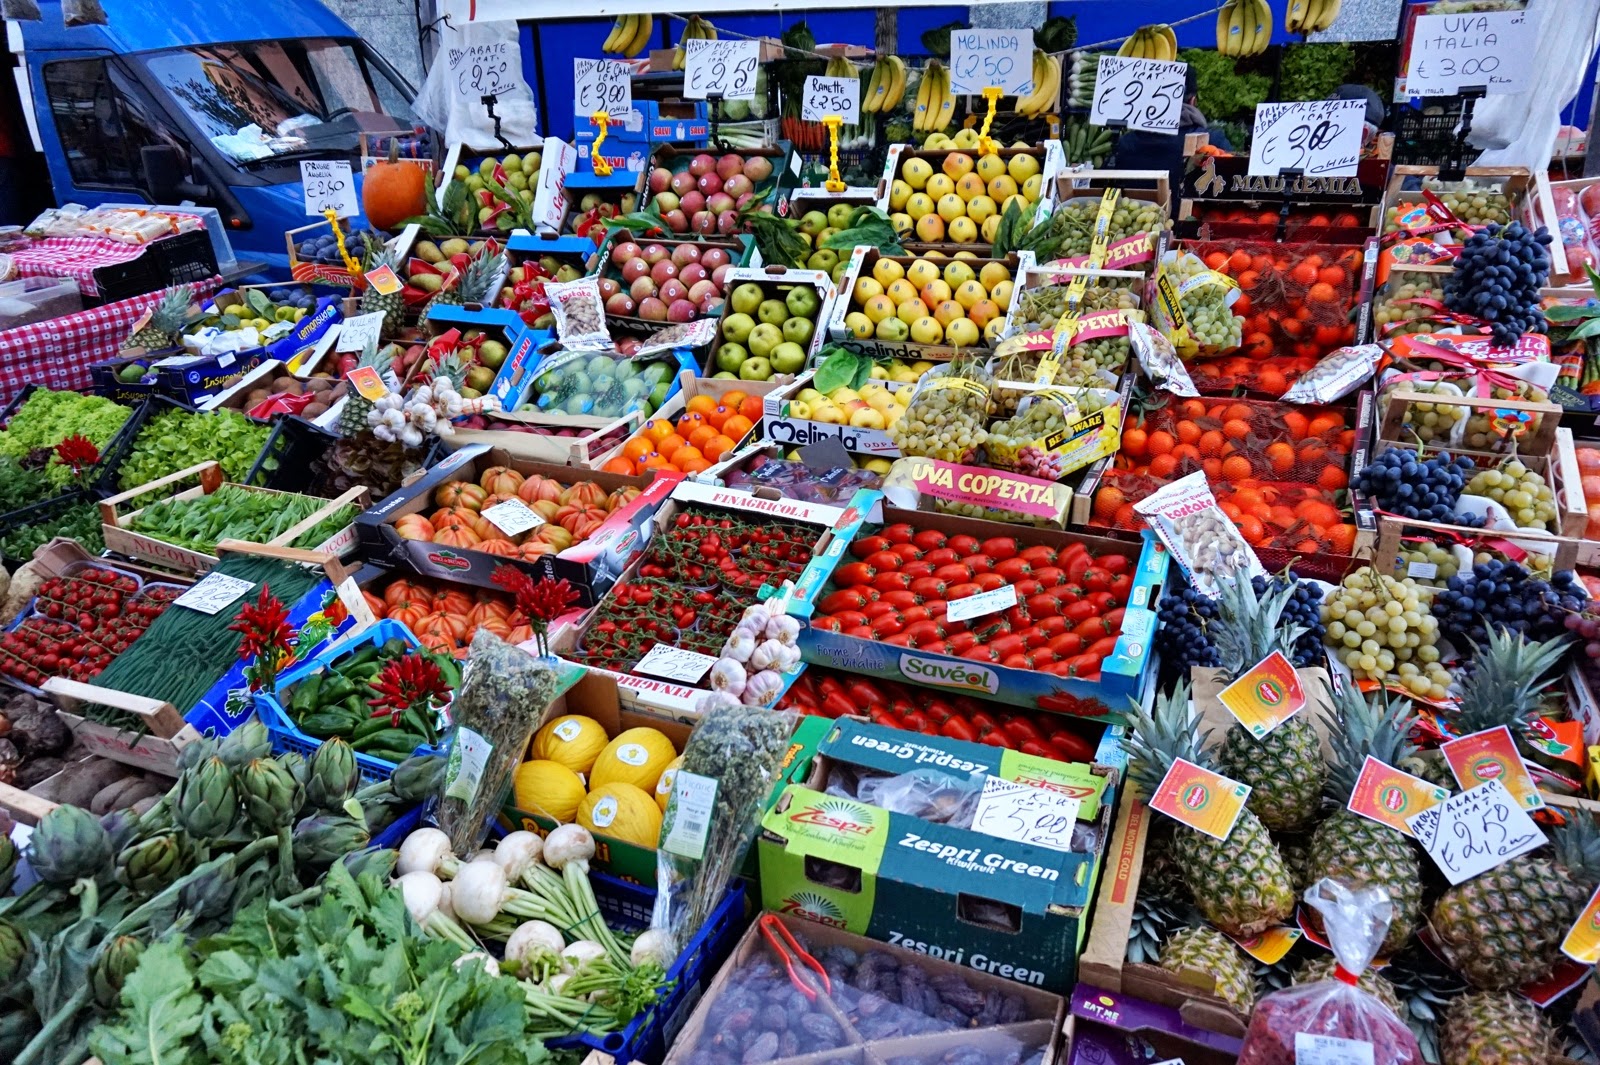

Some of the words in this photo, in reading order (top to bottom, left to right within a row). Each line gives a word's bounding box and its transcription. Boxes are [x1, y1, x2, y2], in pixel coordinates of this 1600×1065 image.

[1444, 16, 1488, 33] UVA
[470, 43, 506, 56] ABATE
[1425, 33, 1498, 49] ITALIA
[1080, 237, 1153, 269] CPERTA
[511, 337, 531, 371] SALVI
[839, 342, 922, 358] Melinda
[1472, 350, 1535, 359] Scelta
[1049, 416, 1102, 447] BEWARE
[911, 463, 953, 489] UVA
[958, 473, 1055, 507] COPERTA
[373, 497, 405, 516] Tomates
[712, 493, 811, 518] FINAGRICOLA
[1164, 499, 1214, 520] tostate
[134, 538, 197, 567] NICOLI
[817, 643, 848, 657] Forme
[832, 657, 839, 666] &
[906, 658, 990, 689] Savéol
[852, 734, 915, 760] Green
[915, 749, 989, 775] Zespri
[790, 806, 875, 835] Zespri
[1131, 813, 1140, 830] DEL
[899, 832, 981, 864] Zespri
[984, 851, 1060, 882] Green
[1125, 831, 1137, 860] MONTE
[946, 856, 997, 875] Kiwifruit
[1119, 861, 1130, 881] GOLD
[782, 899, 848, 930] Zespri
[887, 931, 965, 964] Zespri
[969, 953, 1046, 986] Green
[1084, 1001, 1102, 1016] EAT
[1104, 1008, 1120, 1019] ME
